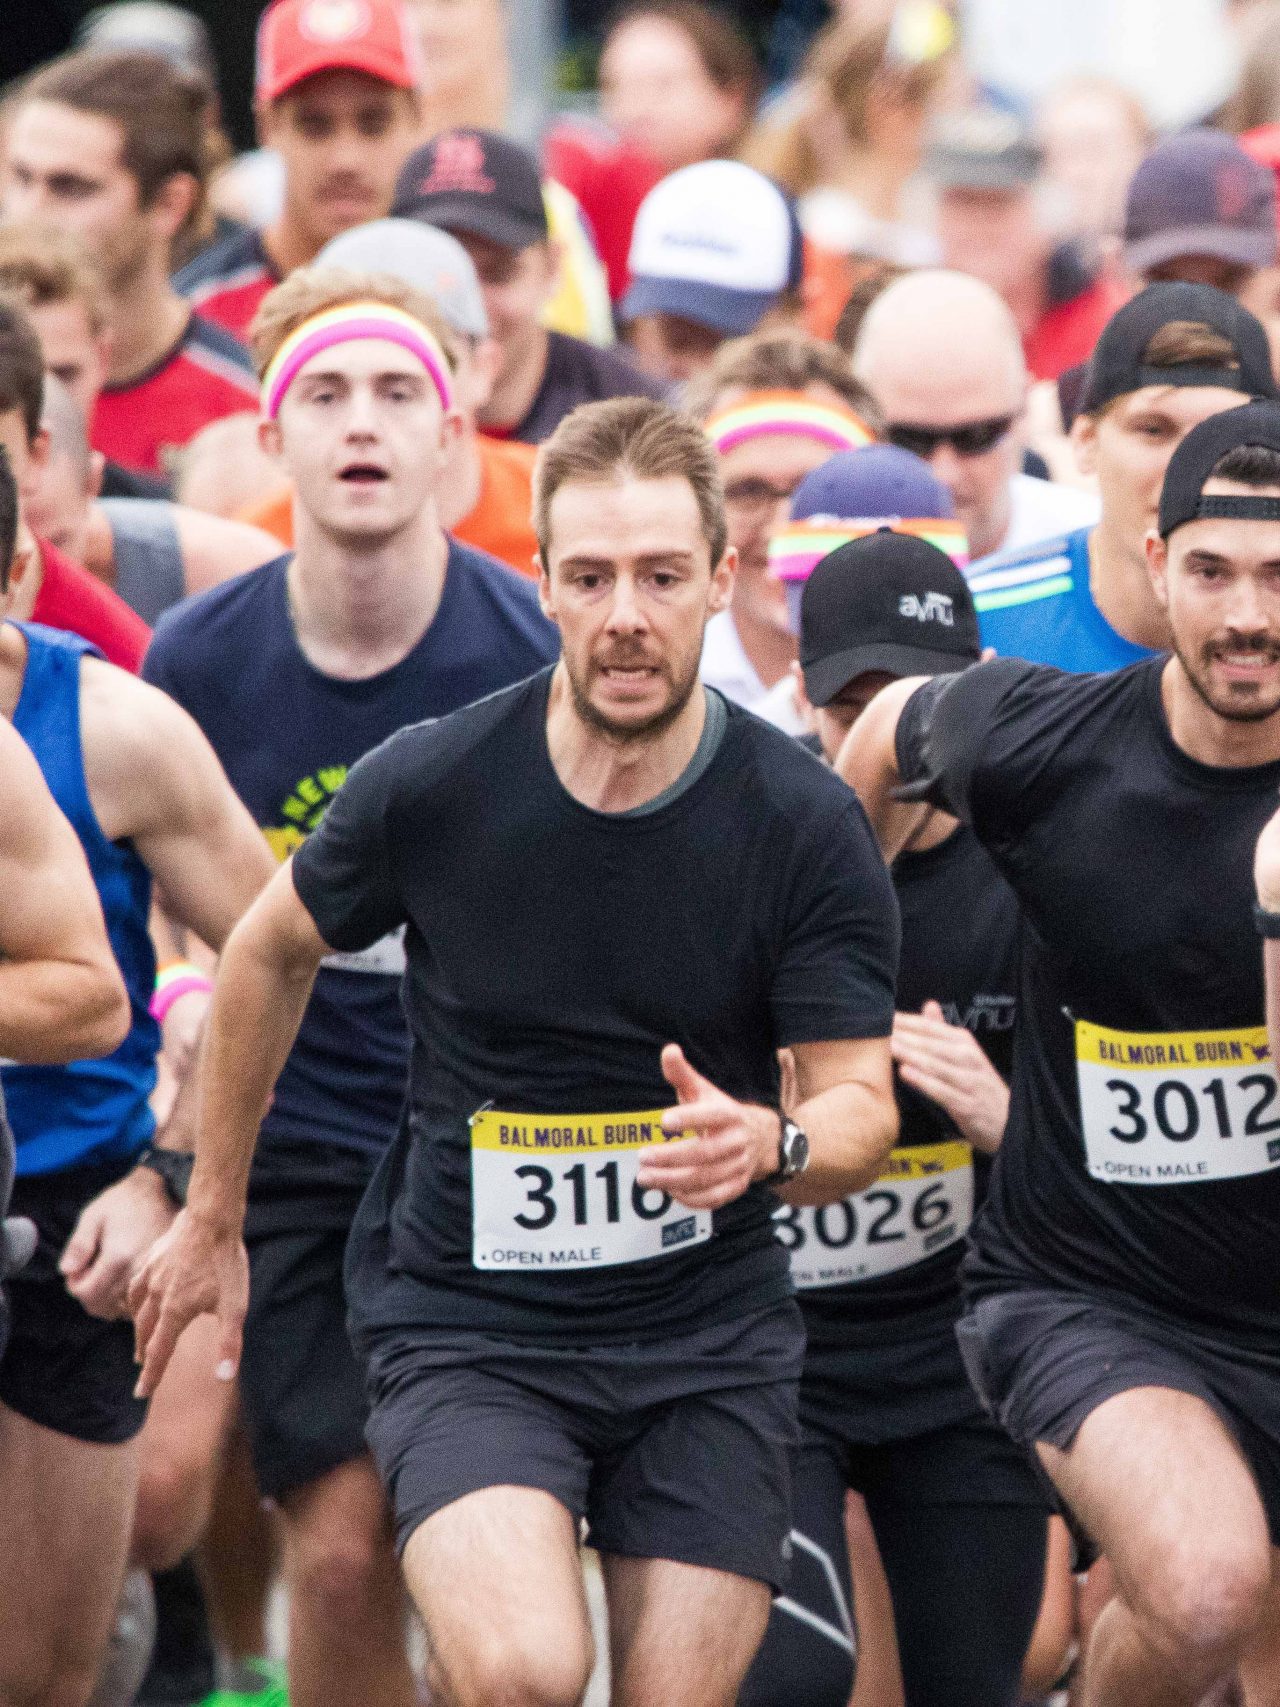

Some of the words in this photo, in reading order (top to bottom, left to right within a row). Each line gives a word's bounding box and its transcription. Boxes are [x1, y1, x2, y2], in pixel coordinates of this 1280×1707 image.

[1099, 1039, 1188, 1065] BALMORAL
[1194, 1041, 1242, 1062] BURN
[500, 1124, 598, 1148] BALMORAL
[604, 1122, 652, 1145] BURN
[1104, 1160, 1150, 1178] OPEN
[1157, 1160, 1209, 1178] MALE
[513, 1160, 672, 1230] 3116
[492, 1248, 544, 1264] OPEN
[550, 1246, 602, 1263] MALE
